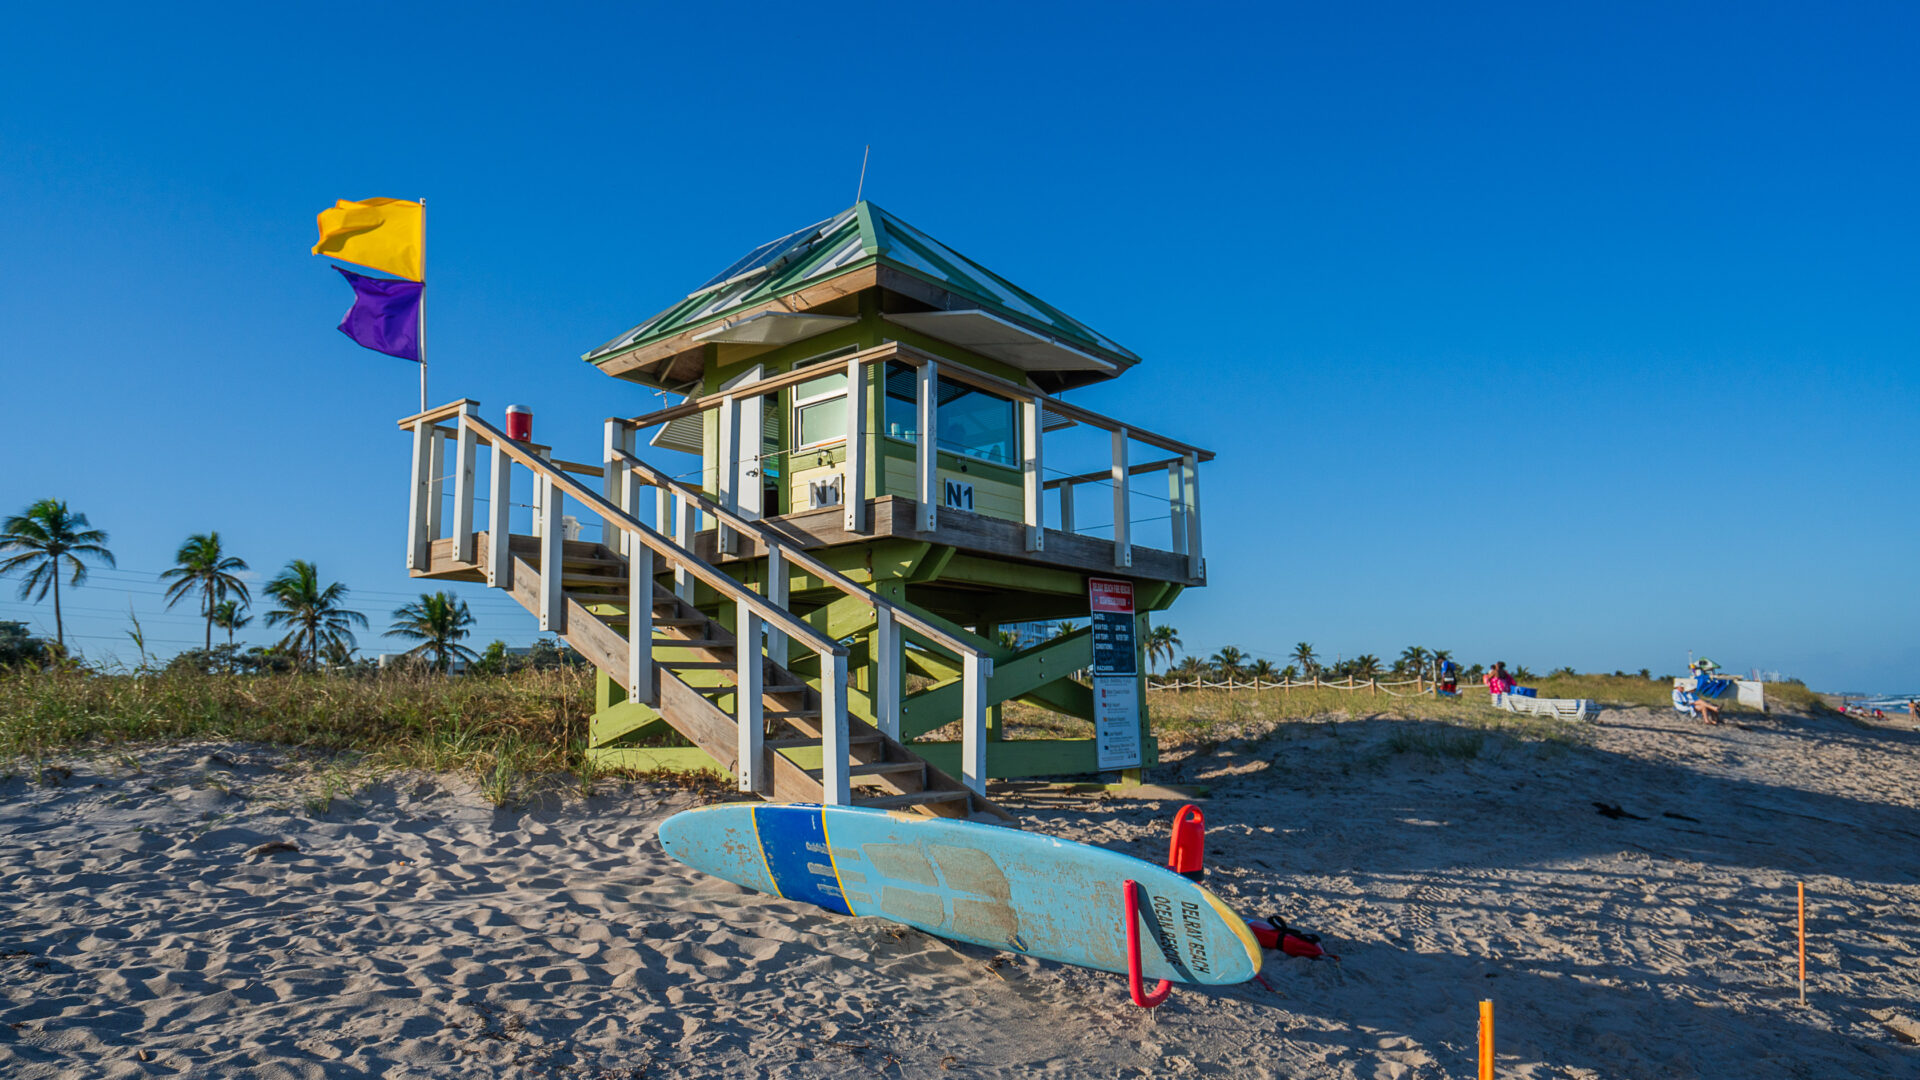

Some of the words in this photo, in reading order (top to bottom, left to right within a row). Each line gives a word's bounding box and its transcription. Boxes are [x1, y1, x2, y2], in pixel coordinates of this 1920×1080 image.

[809, 476, 840, 507] N1
[946, 482, 973, 510] N1
[1153, 895, 1175, 930] OCEAN
[1181, 900, 1204, 942] DELRAY
[1160, 929, 1183, 967] RESCUE
[1187, 940, 1210, 975] BEACH
